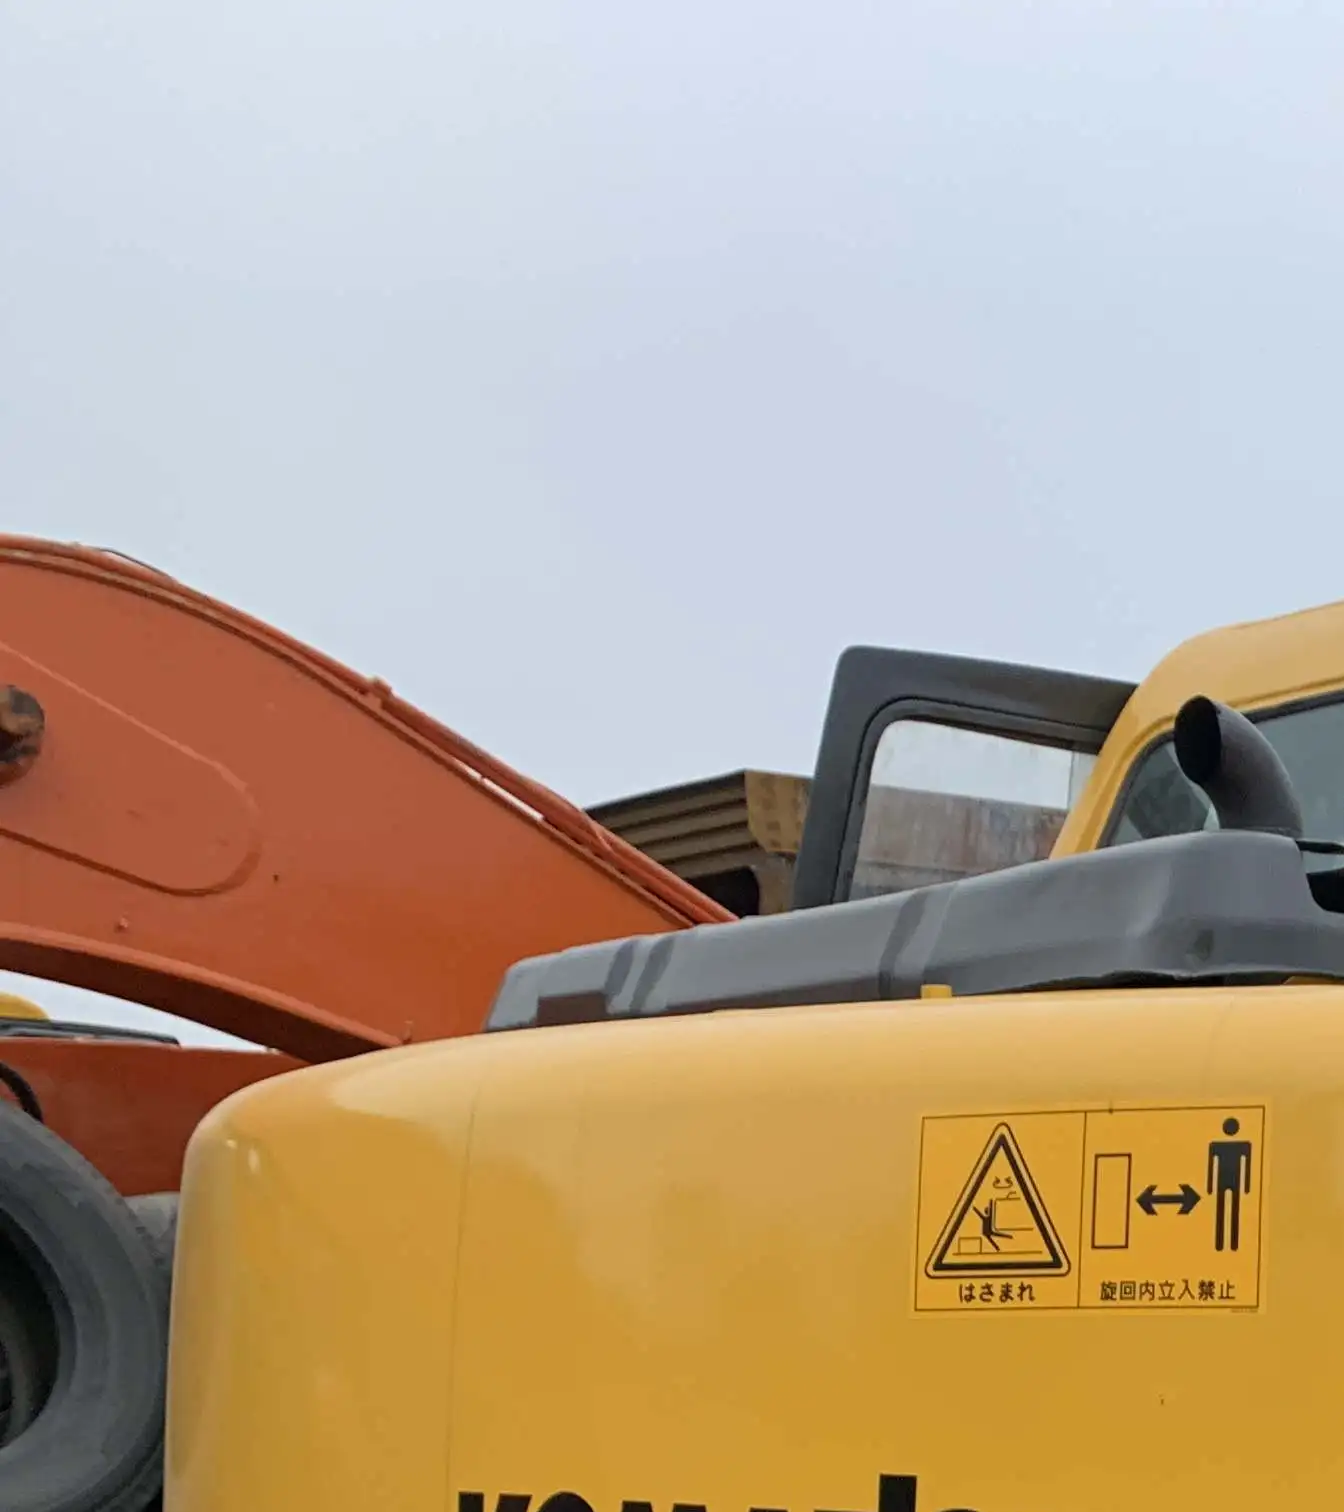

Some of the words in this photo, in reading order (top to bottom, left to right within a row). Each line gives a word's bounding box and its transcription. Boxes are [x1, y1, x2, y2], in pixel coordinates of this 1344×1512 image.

[958, 1282, 1036, 1303] はさまれ
[1099, 1279, 1237, 1302] 旋回内立入禁止
